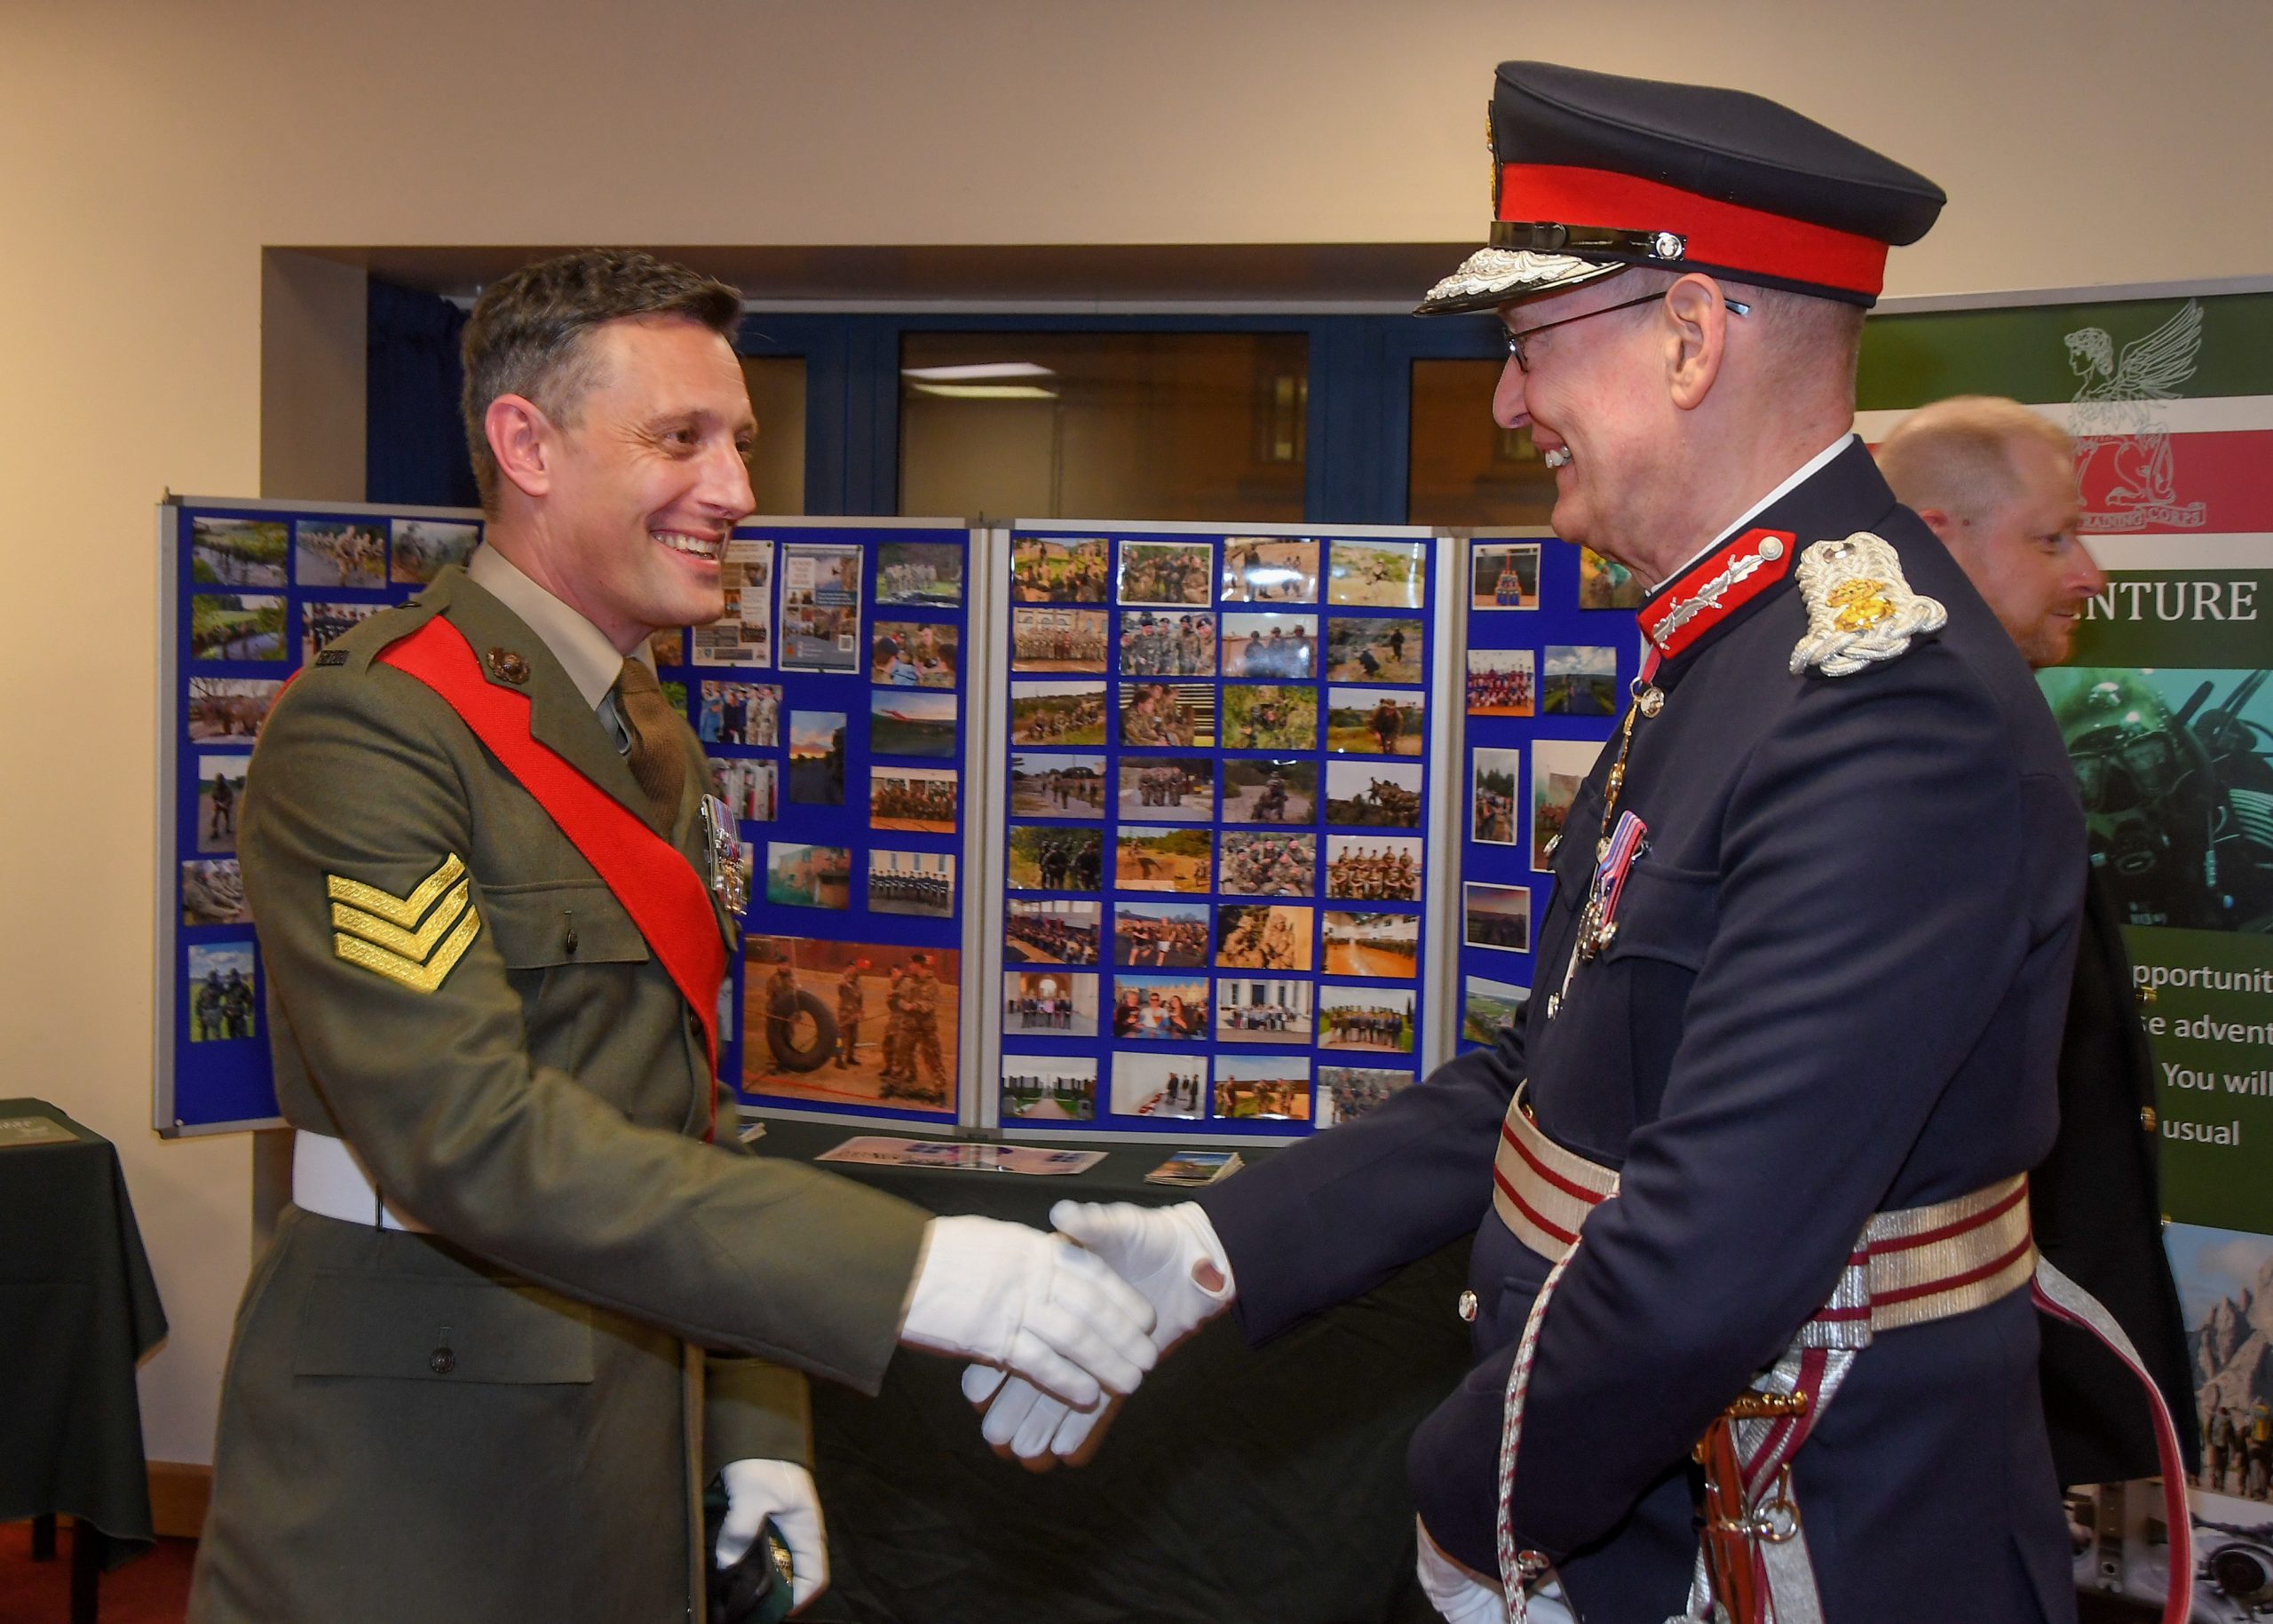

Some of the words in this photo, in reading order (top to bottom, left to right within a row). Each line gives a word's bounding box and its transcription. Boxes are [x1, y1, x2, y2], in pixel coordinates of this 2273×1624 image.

[2071, 582, 2258, 620] NTURE
[2161, 1062, 2215, 1091] You
[2223, 1070, 2273, 1097] will
[2162, 1120, 2240, 1146] usual
